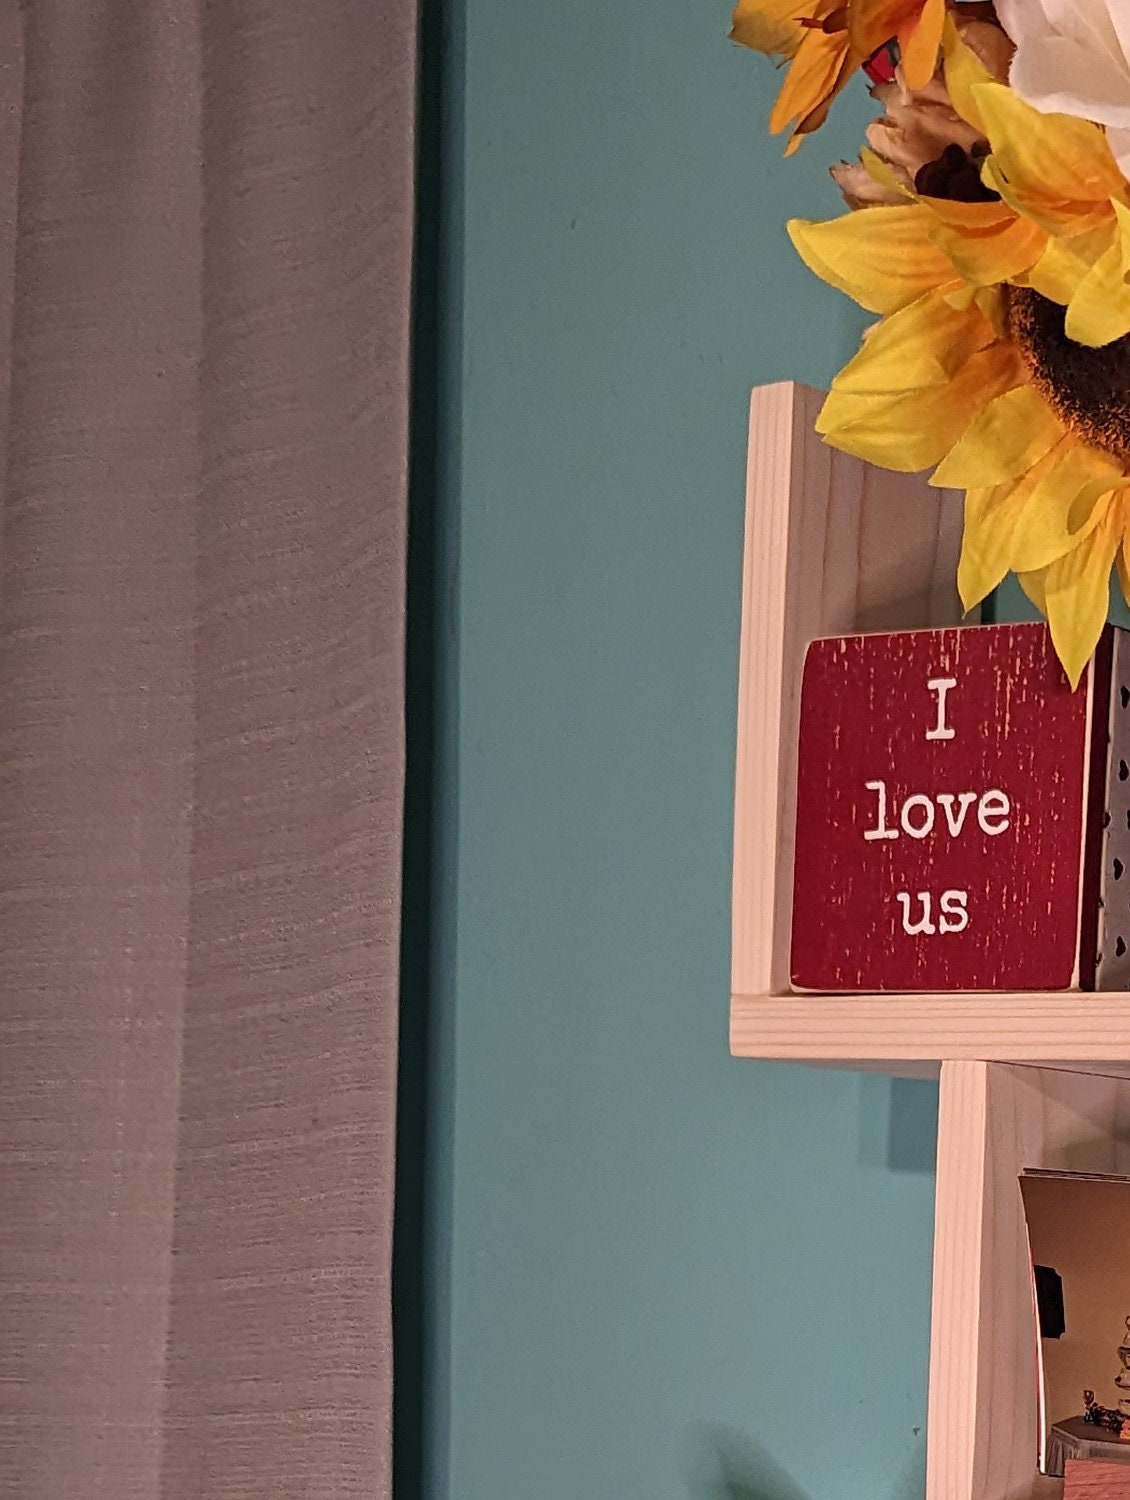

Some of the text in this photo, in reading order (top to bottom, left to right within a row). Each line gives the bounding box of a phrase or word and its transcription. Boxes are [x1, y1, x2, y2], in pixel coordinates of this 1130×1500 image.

[924, 677, 958, 741] I
[863, 780, 1011, 840] love
[895, 889, 969, 935] us
